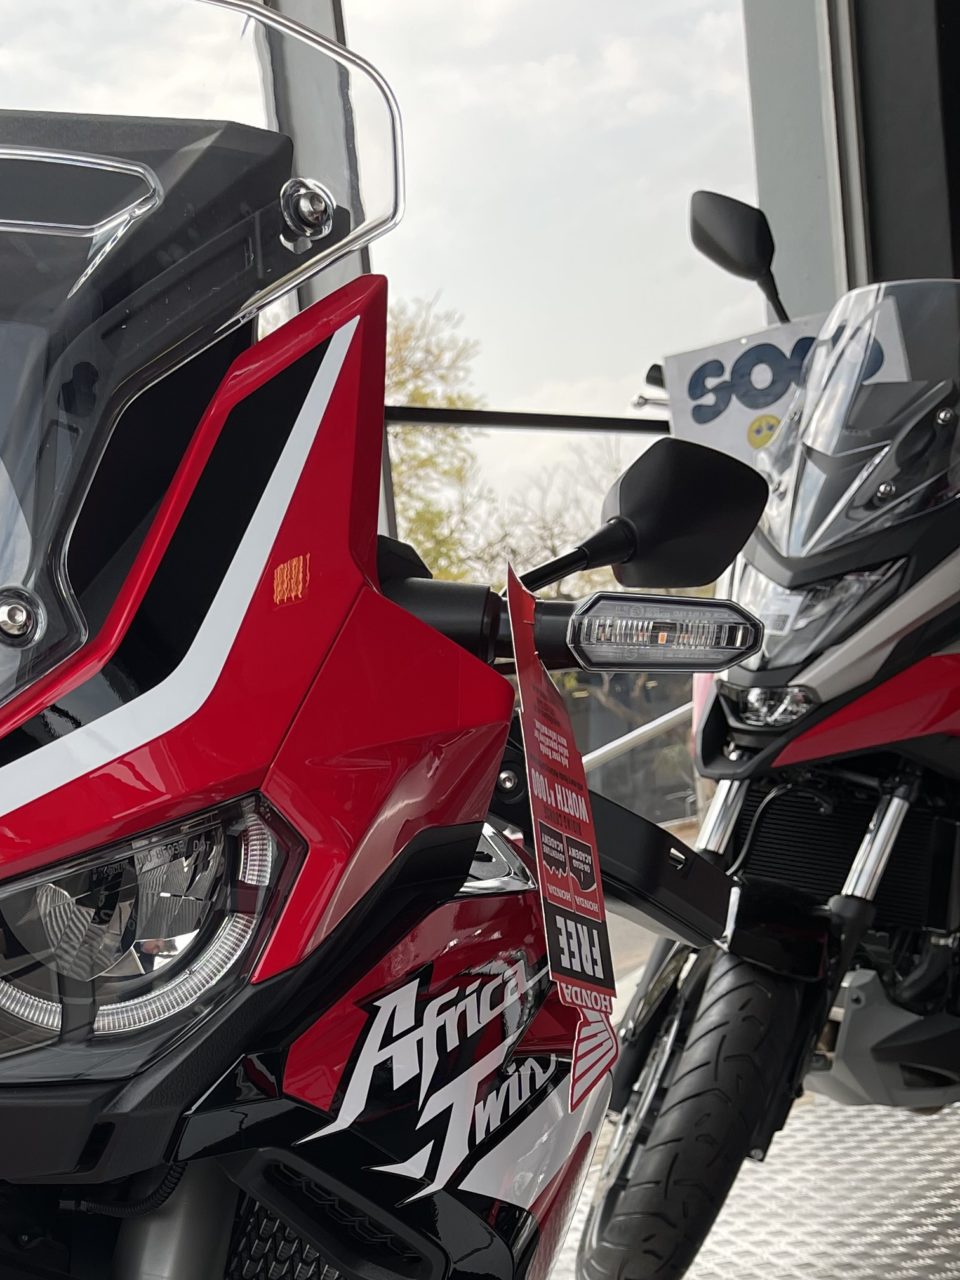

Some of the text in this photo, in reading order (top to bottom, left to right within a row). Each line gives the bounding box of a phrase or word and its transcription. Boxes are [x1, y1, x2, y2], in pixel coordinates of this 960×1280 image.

[688, 325, 884, 425] SO
[555, 783, 589, 823] WORTH
[547, 883, 572, 902] HONDA
[574, 895, 599, 913] HONDA
[555, 915, 604, 979] FREE
[562, 981, 613, 1013] HONDA
[292, 958, 550, 1146] Africa
[366, 1024, 557, 1207] Twin
